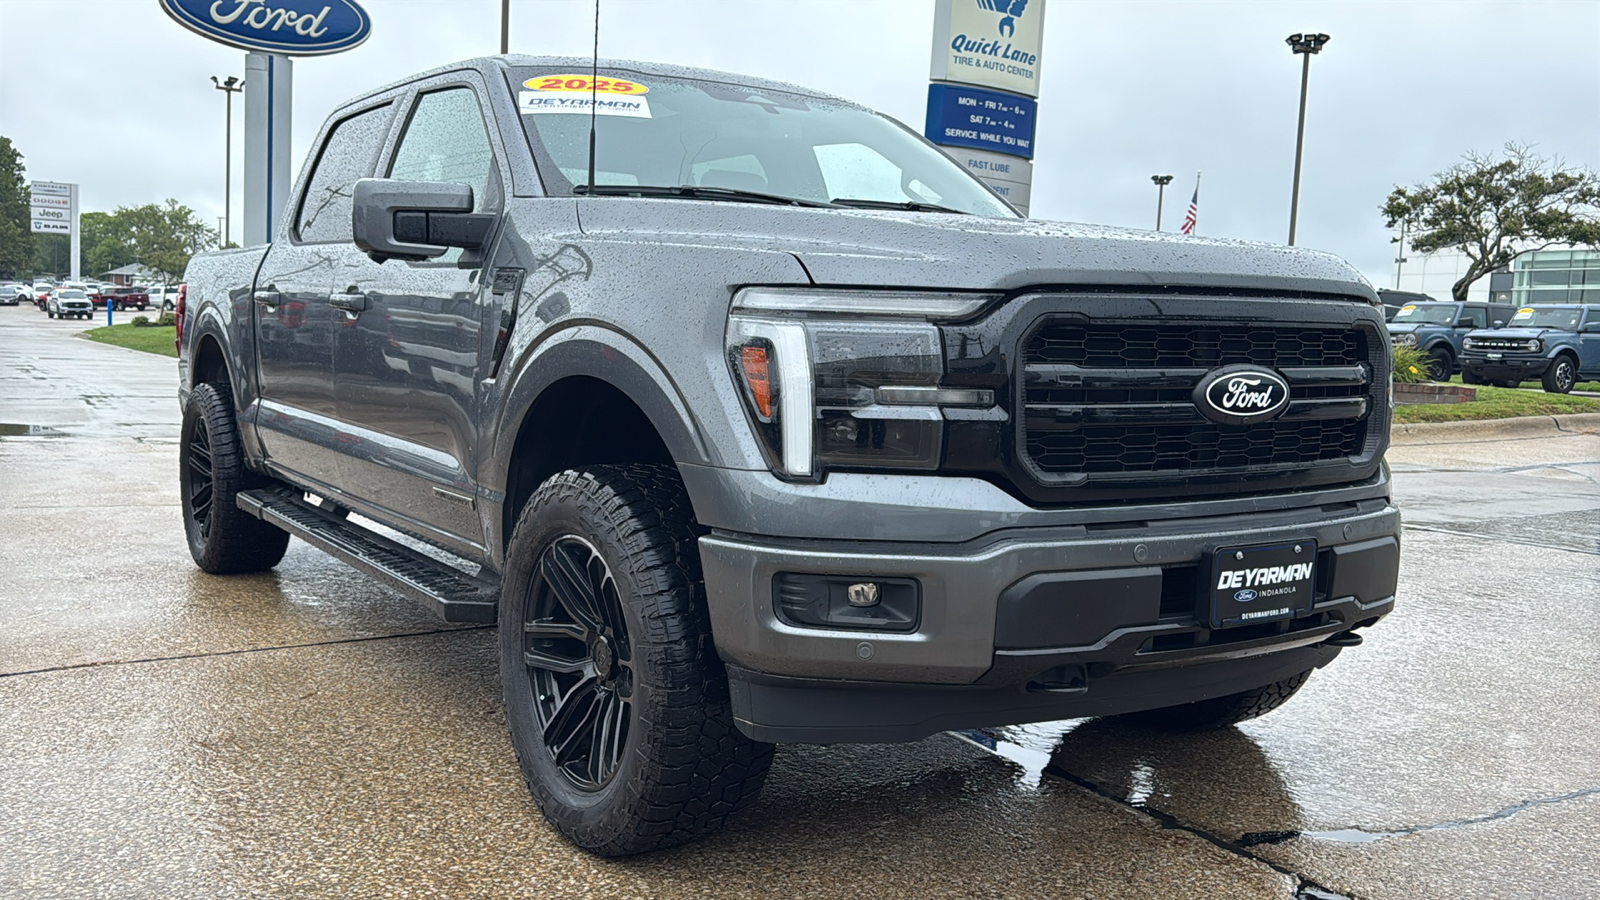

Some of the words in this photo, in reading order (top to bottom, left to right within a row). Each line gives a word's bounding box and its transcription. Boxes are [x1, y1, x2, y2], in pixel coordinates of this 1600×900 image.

[951, 34, 1002, 57] Quick
[1001, 43, 1036, 66] Lane
[953, 55, 974, 67] TIRE
[975, 59, 982, 68] &
[983, 60, 1005, 72] AUTO
[1006, 65, 1034, 79] CENTER
[538, 78, 634, 92] 2025
[528, 97, 641, 109] DEYARMAN
[958, 96, 977, 107] MON
[984, 100, 997, 110] FRI
[969, 114, 984, 124] SAT
[945, 127, 978, 140] SERVICE
[979, 132, 1001, 143] WHILE
[1002, 135, 1016, 146] YOU
[1016, 139, 1030, 149] WAIT
[968, 159, 989, 170] FAST
[989, 161, 1010, 173] LUBE
[39, 209, 63, 219] Jeep
[1222, 377, 1273, 408] Ford
[1217, 562, 1313, 590] DEYARMAN
[1259, 586, 1297, 597] INDIANOLA
[1241, 607, 1290, 620] DEYARMANFORD.COM
